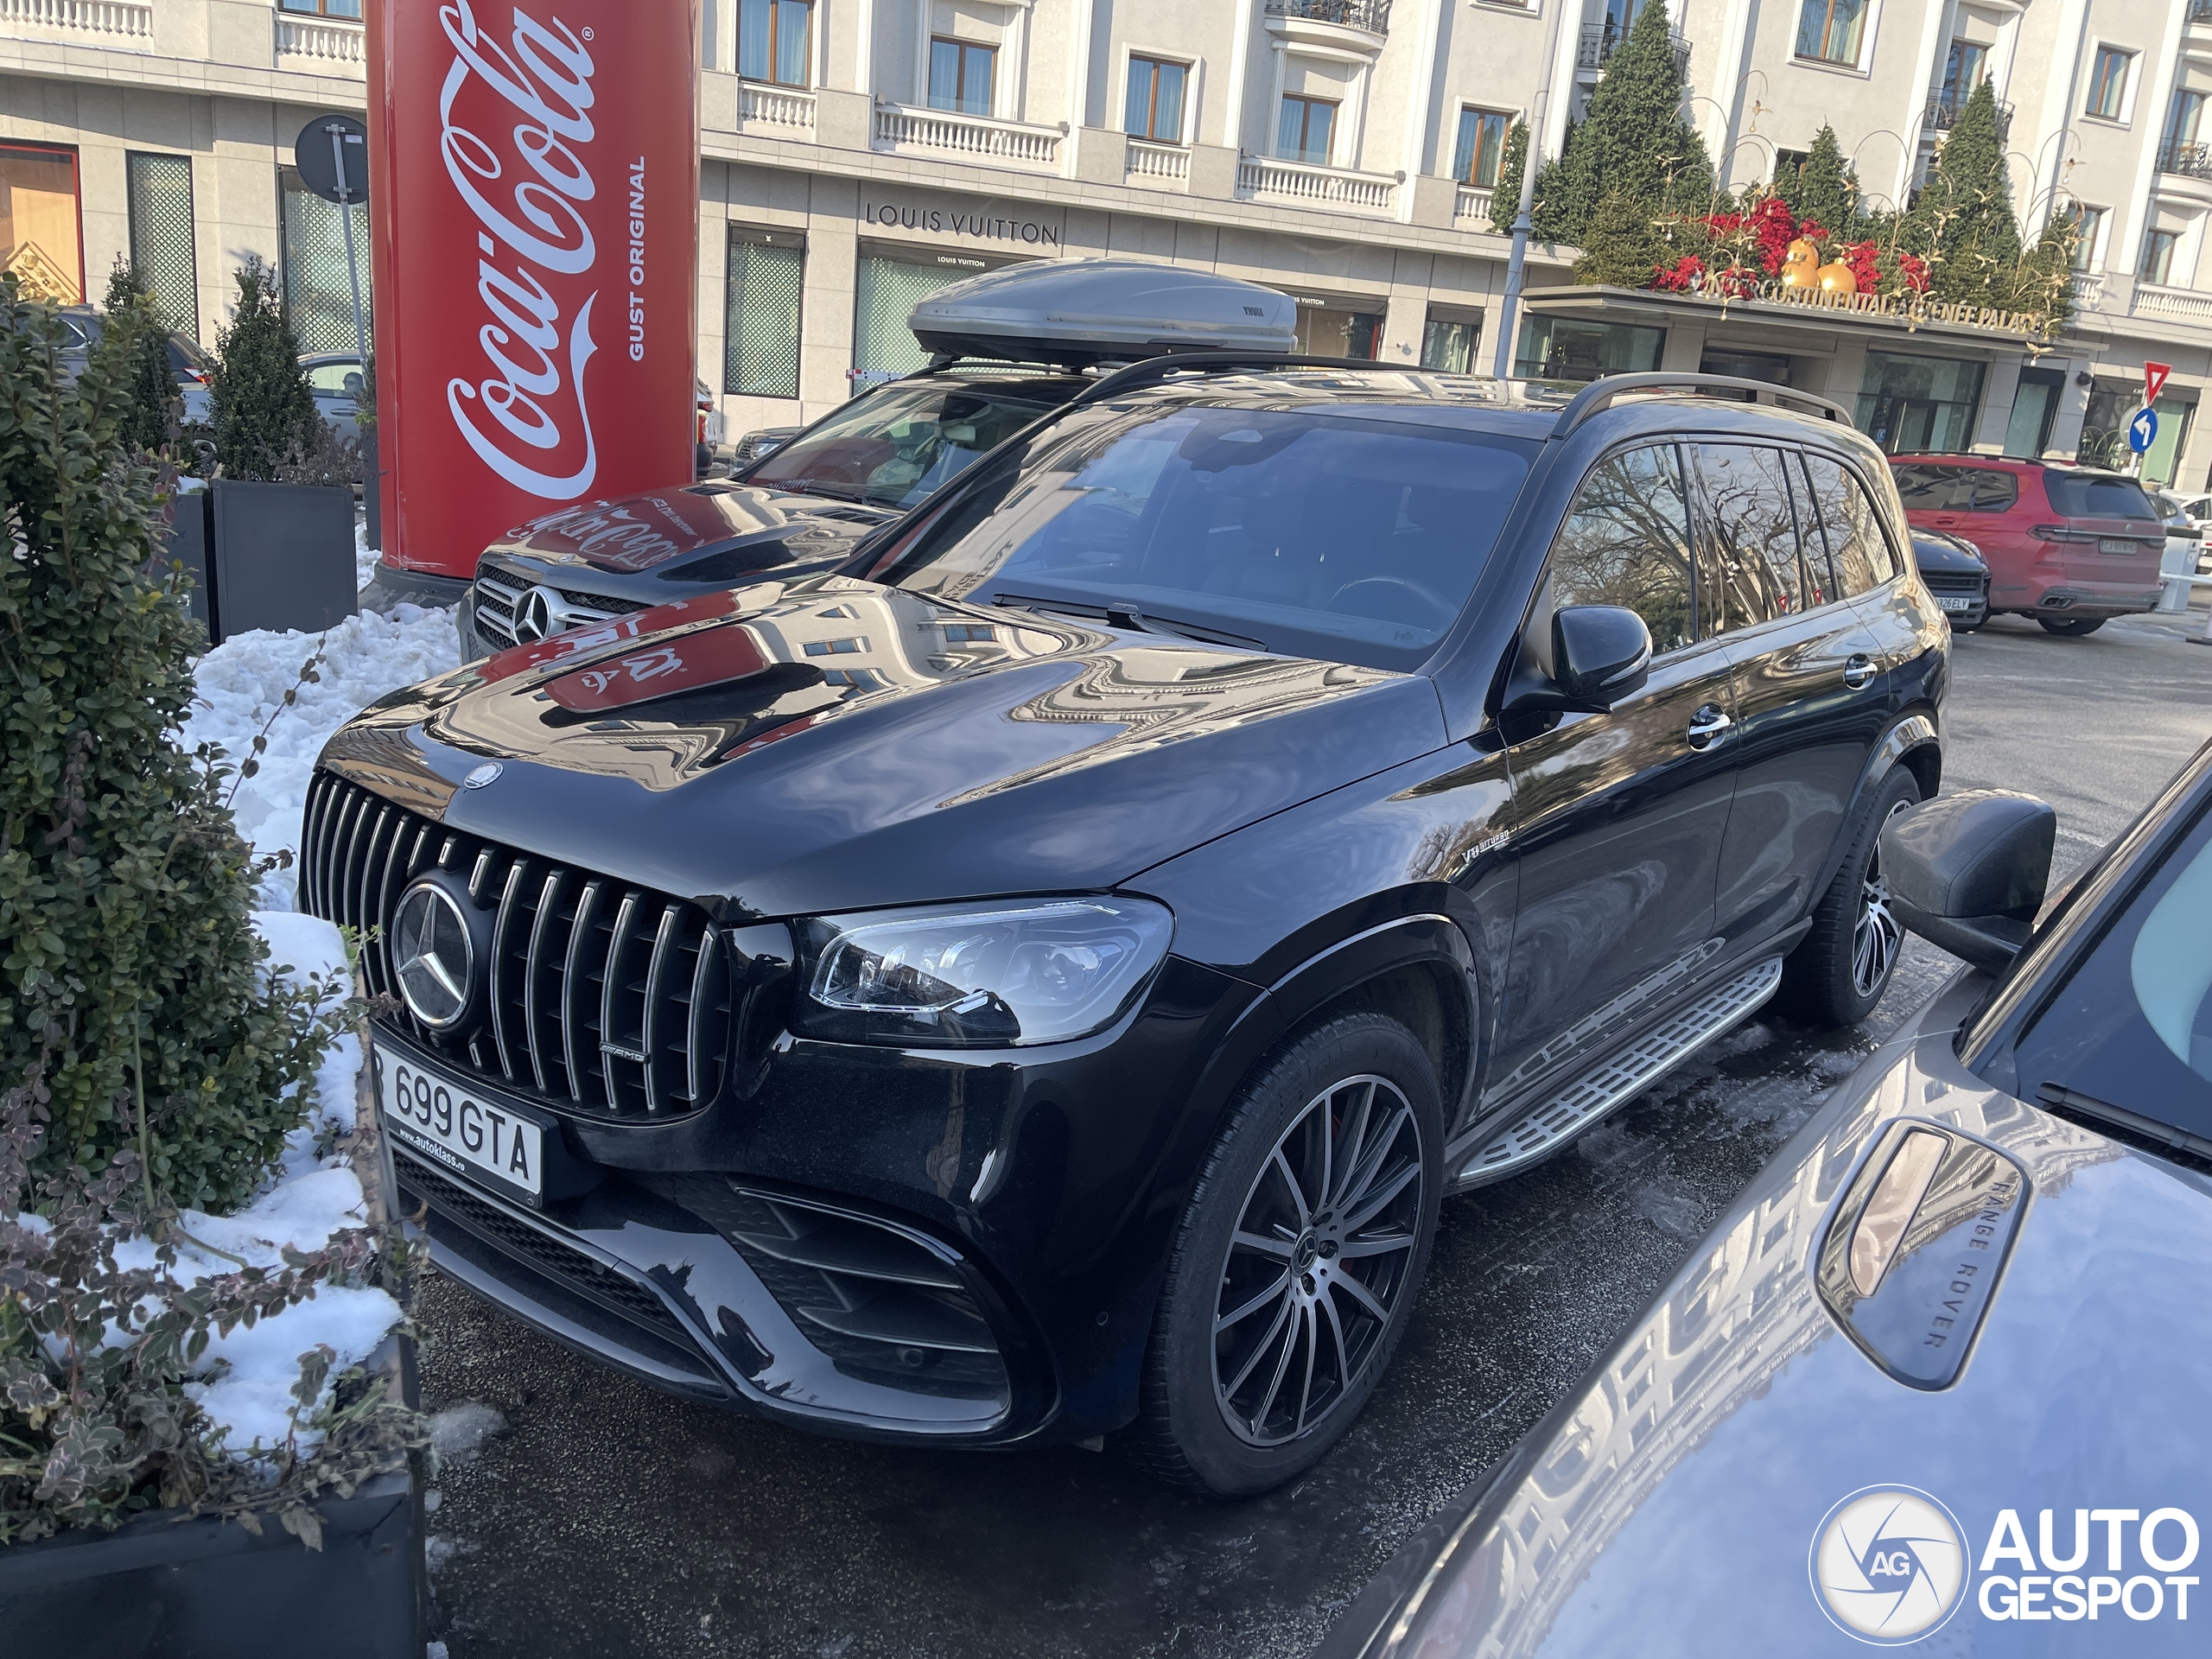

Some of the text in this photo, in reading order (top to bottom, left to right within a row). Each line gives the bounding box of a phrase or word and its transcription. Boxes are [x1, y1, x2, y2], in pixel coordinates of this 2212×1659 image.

[866, 202, 1058, 247] LOUIS VUITTON
[439, 0, 598, 499] Coca-Cola
[628, 156, 645, 362] GUST ORIGINAL
[937, 256, 986, 268] LOUIS VUITTON
[1243, 306, 1264, 317] THULE
[1300, 297, 1325, 306] VUITTON
[1953, 599, 1968, 609] ELY
[1461, 844, 1480, 863] V8
[1479, 830, 1510, 850] BITURBO
[611, 1047, 645, 1062] AMG
[396, 1065, 452, 1137] 699
[459, 1099, 530, 1181] GTA
[398, 1127, 466, 1173] www.autoklass.ro
[1923, 1181, 2011, 1348] RANGE ROVER
